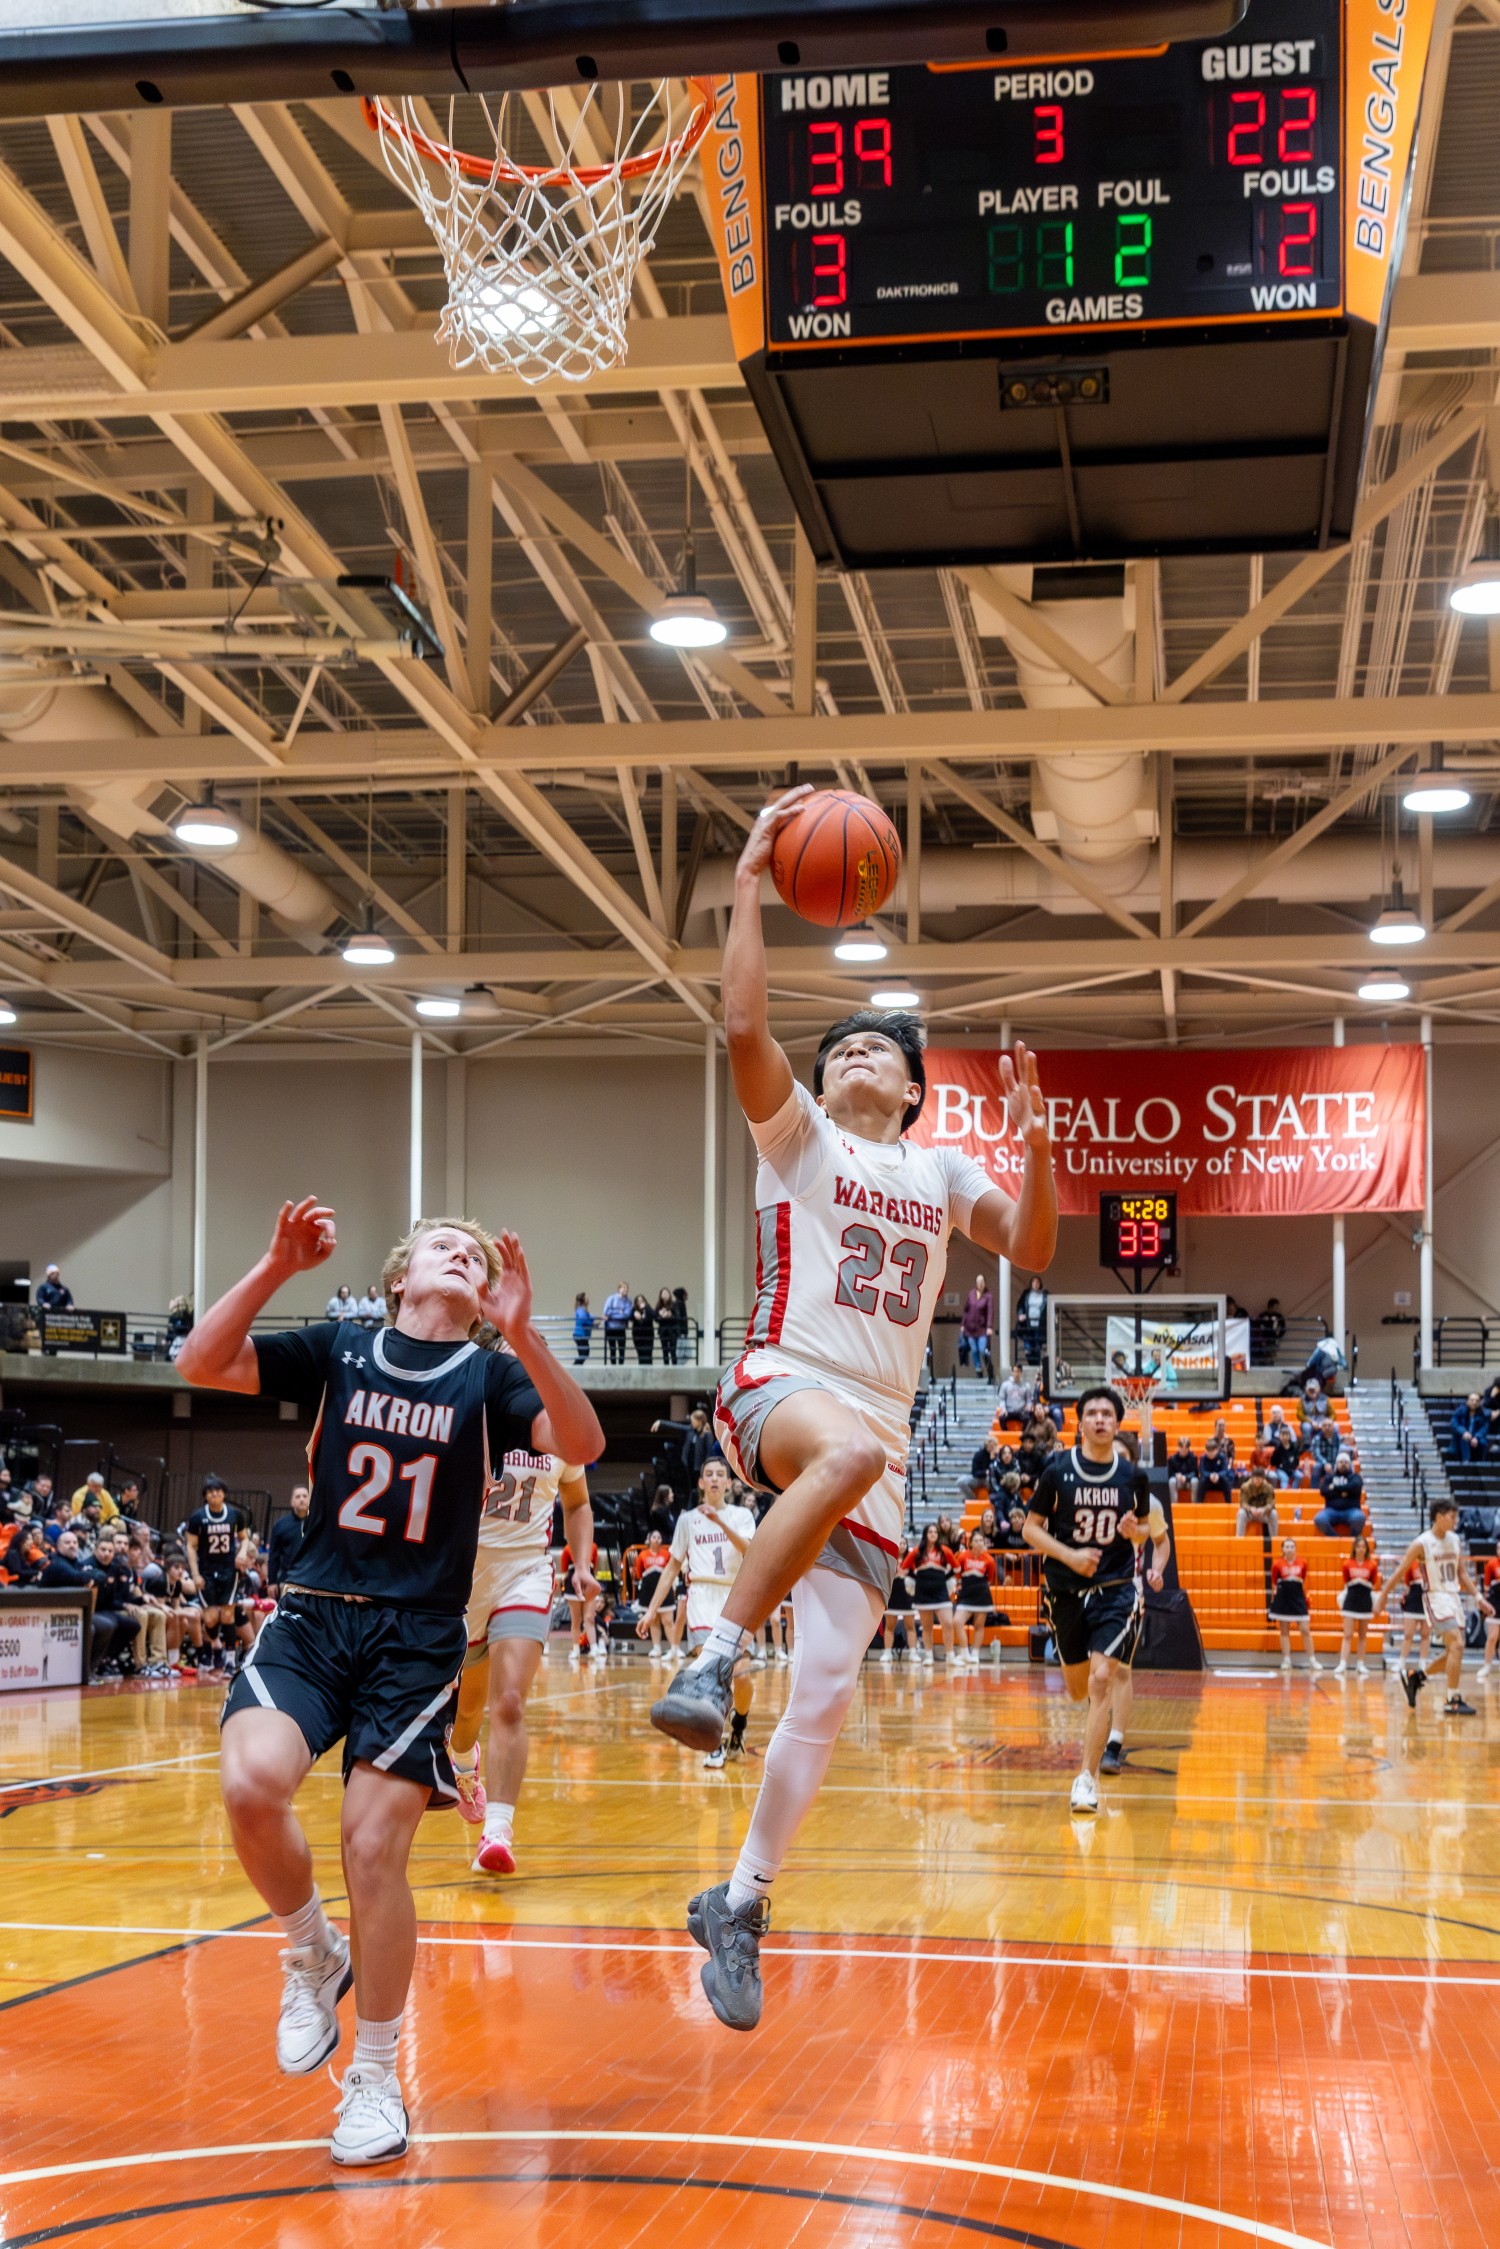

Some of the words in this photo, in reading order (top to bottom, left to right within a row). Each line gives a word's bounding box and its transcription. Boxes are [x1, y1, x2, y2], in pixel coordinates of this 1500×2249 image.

[1201, 40, 1316, 81] GUEST
[781, 72, 890, 111] HOME
[994, 69, 1094, 101] PERIOD
[1033, 105, 1064, 163] 3
[1227, 87, 1317, 166] 22
[809, 118, 893, 195] 39
[714, 73, 757, 298] BENGAL
[978, 185, 1079, 216] PLAYER
[1098, 179, 1170, 208] FOUL
[1243, 166, 1336, 198] FOULS
[775, 200, 862, 230] FOULS
[1114, 213, 1152, 287] 2
[1278, 202, 1316, 277] 2
[812, 234, 847, 307] 3
[877, 282, 960, 299] DAKTRONICS
[1045, 294, 1144, 324] GAMES
[1250, 283, 1317, 311] WON
[788, 312, 851, 339] WON
[931, 1083, 1181, 1144] BUFALO
[1203, 1084, 1379, 1142] STATE
[993, 1146, 1056, 1174] Stae
[1066, 1149, 1198, 1184] University
[1206, 1146, 1236, 1175] of
[1241, 1147, 1304, 1174] New
[1310, 1143, 1377, 1172] York
[833, 1175, 943, 1236] WARRIORS
[1122, 1199, 1168, 1220] 4:28
[1120, 1221, 1158, 1256] 33
[835, 1223, 928, 1327] 23
[344, 1389, 454, 1444] AKRON
[503, 1451, 551, 1472] RRIORS
[338, 1441, 439, 1544] 21
[485, 1472, 537, 1523] 21
[1074, 1487, 1119, 1506] AKRON
[208, 1534, 230, 1554] 23
[694, 1532, 729, 1545] WARRIO
[1073, 1508, 1118, 1546] 30
[713, 1546, 726, 1575] 1
